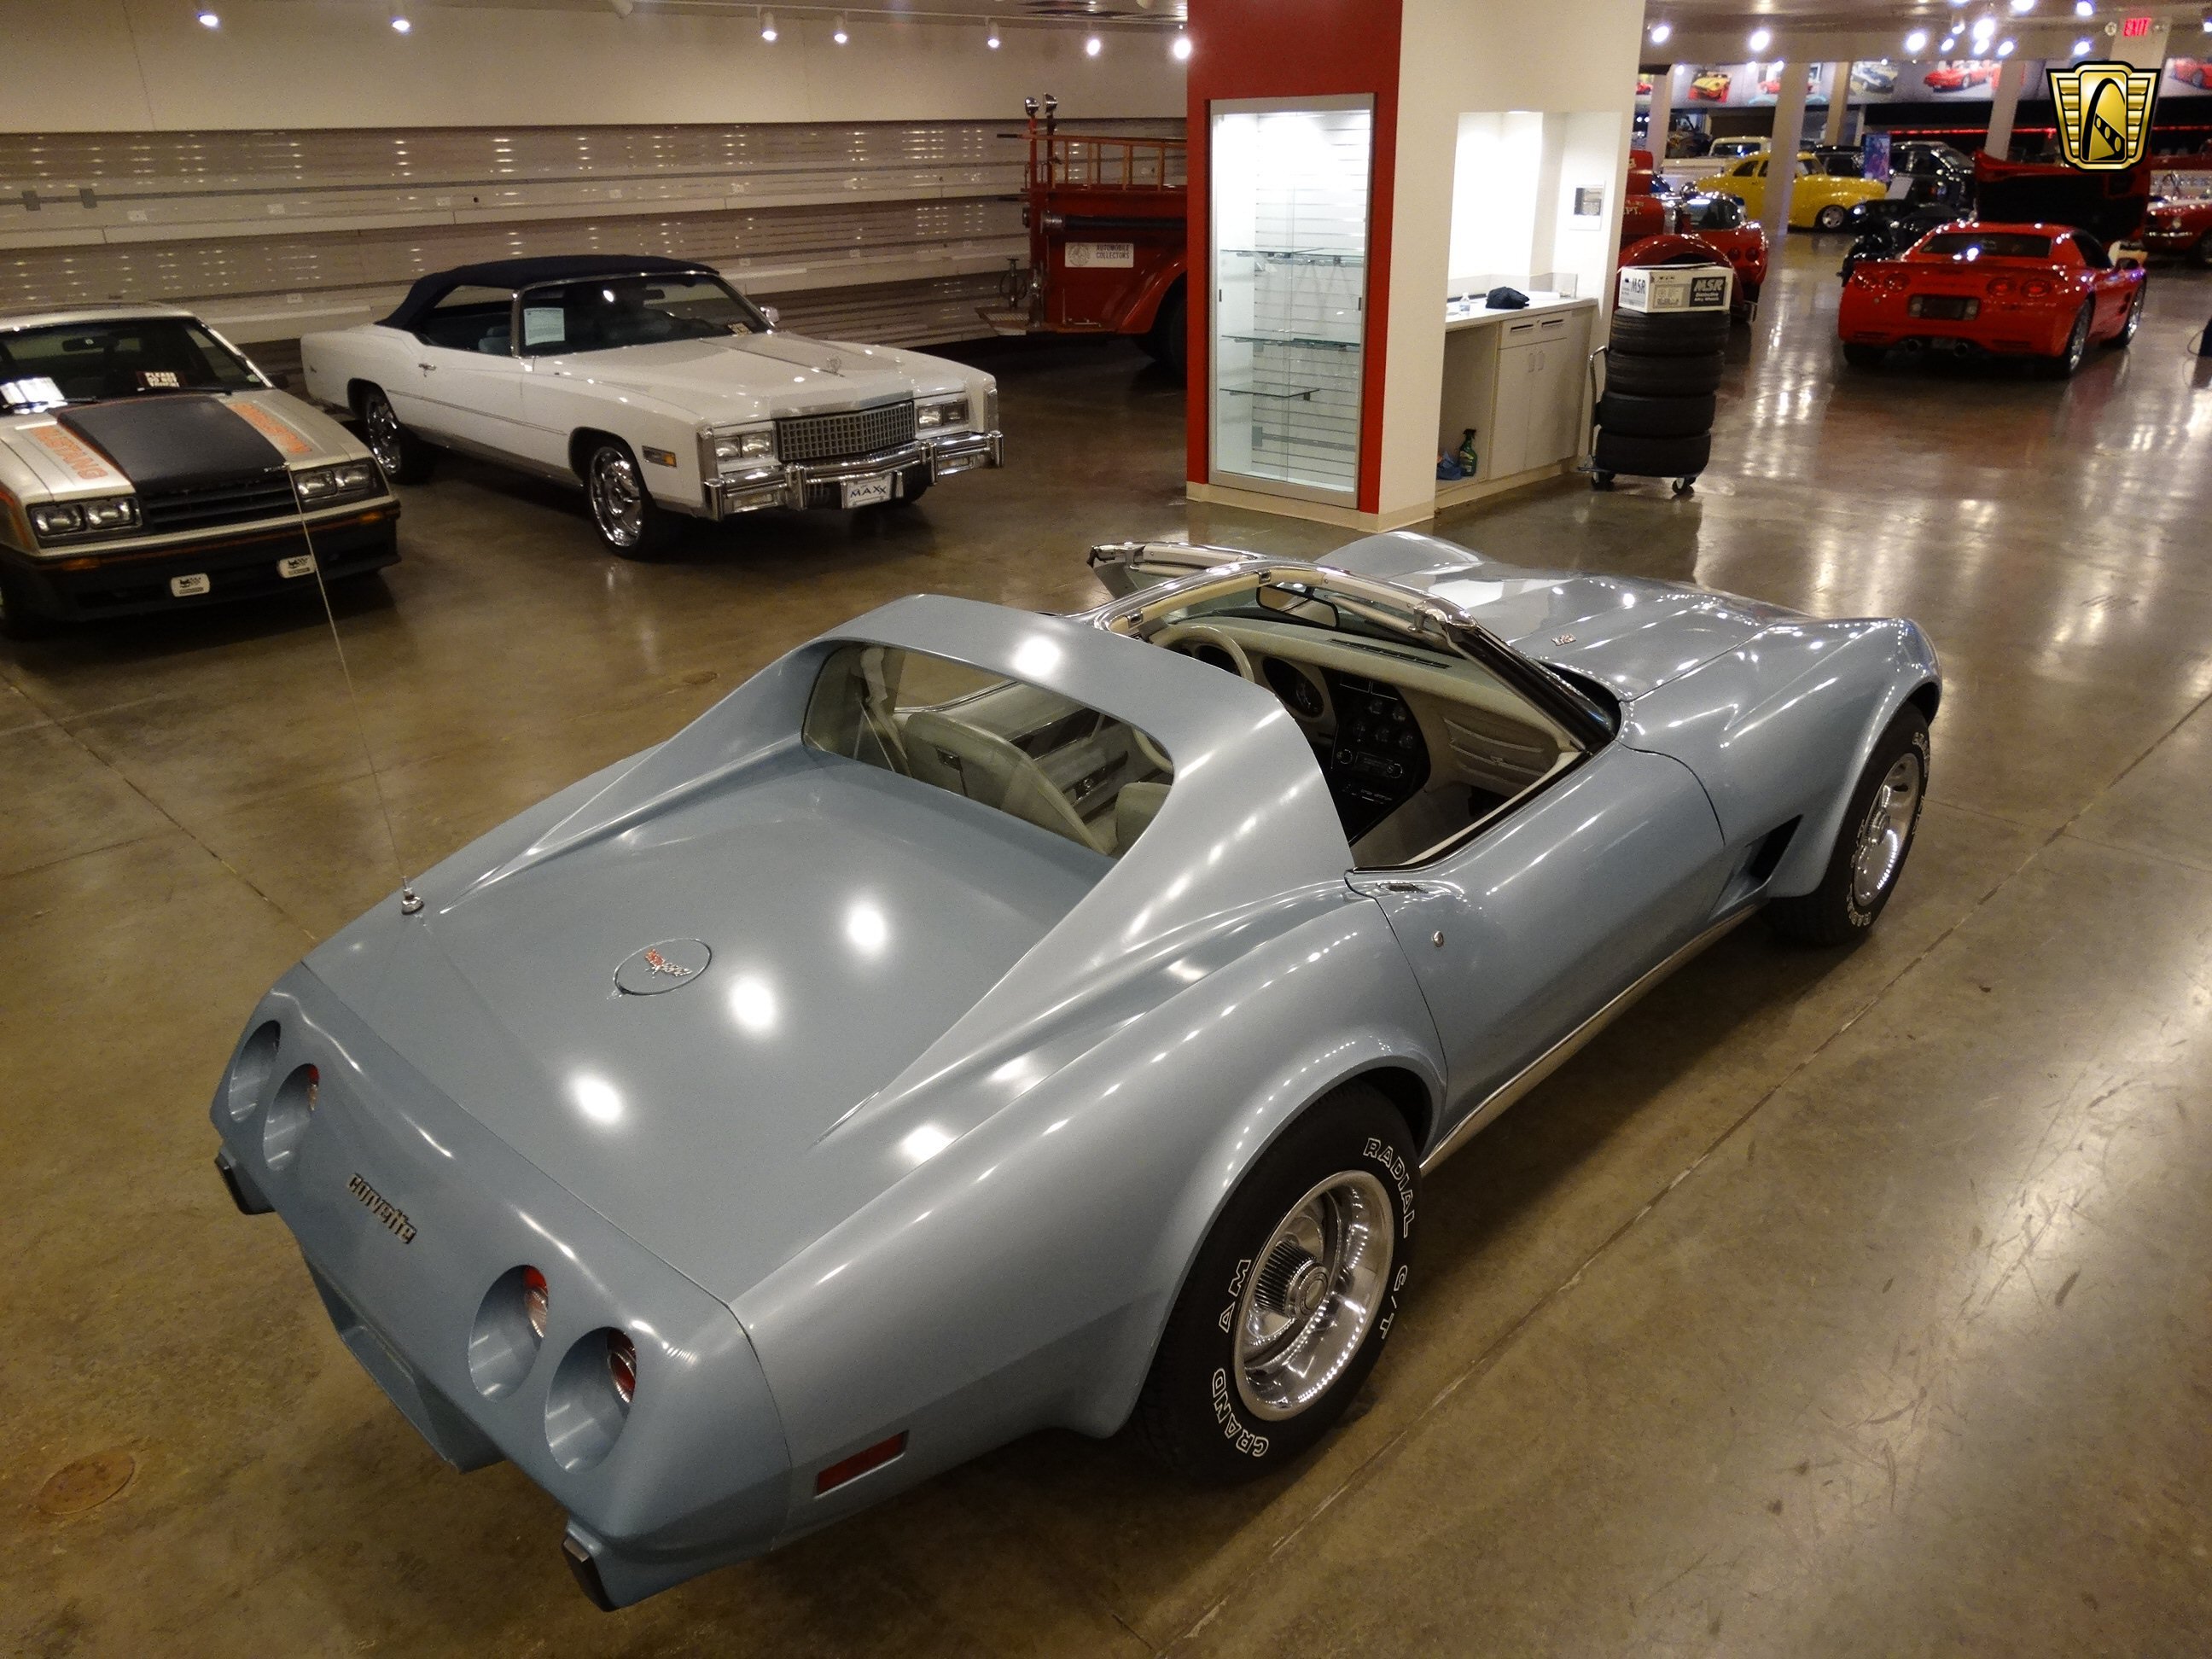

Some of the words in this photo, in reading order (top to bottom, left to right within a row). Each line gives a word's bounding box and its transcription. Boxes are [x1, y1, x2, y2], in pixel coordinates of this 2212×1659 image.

[2123, 17, 2151, 37] EXIT
[1631, 277, 1646, 294] MSR
[1693, 278, 1724, 292] MSR
[850, 486, 887, 498] MAXX
[1363, 1138, 1415, 1238] RADIAL
[1219, 1259, 1252, 1333] AM
[1212, 1368, 1269, 1458] GRAND
